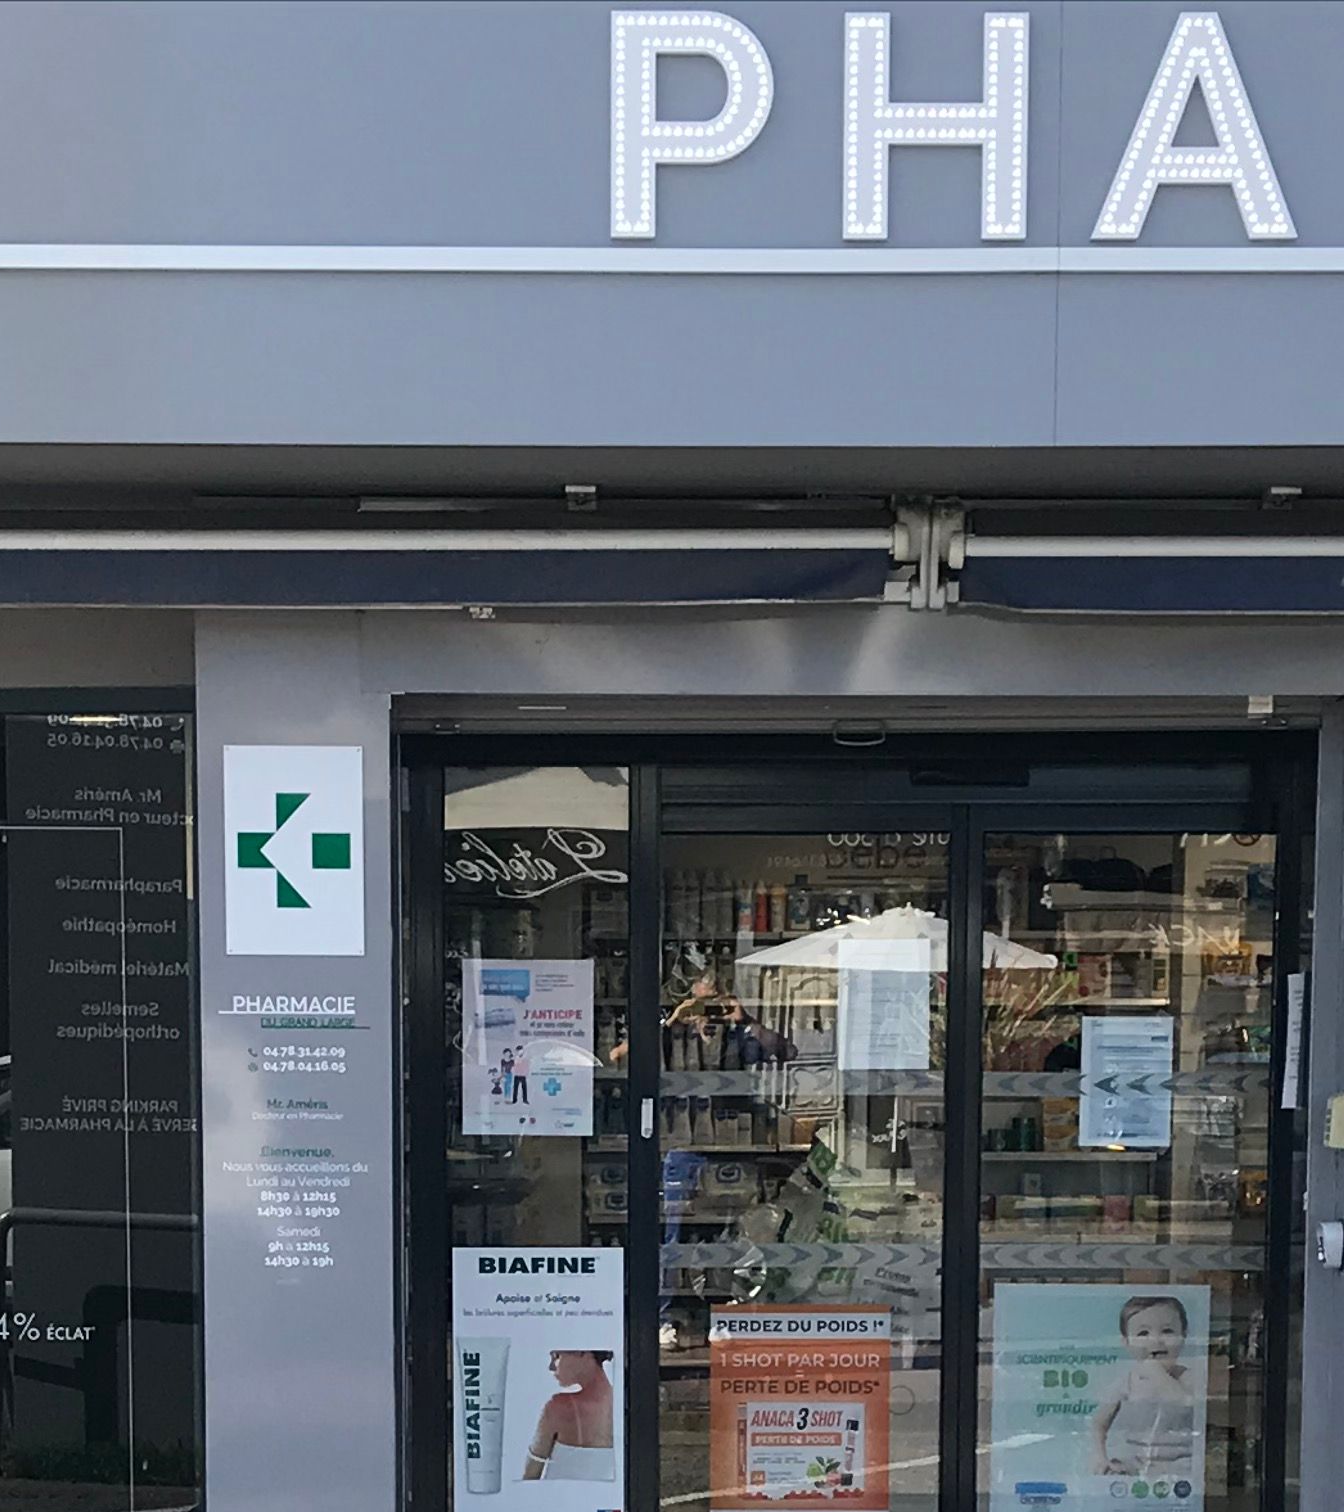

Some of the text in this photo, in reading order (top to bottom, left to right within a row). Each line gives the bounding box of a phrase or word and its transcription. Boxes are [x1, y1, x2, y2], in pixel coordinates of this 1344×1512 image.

[232, 995, 355, 1013] PHARMACIE
[523, 1009, 583, 1020] J'ANTICIPE
[262, 1046, 346, 1058] 04.78.31.42.09
[262, 1061, 346, 1074] 04.78.04.16.05
[352, 1161, 368, 1173] du
[297, 1176, 351, 1187] Vendredi
[261, 1191, 290, 1203] 8h30
[302, 1191, 336, 1203] 12h15
[257, 1206, 292, 1217] 14h30
[305, 1206, 340, 1217] 19h30
[277, 1226, 320, 1237] Samedi
[268, 1241, 283, 1253] 9h
[296, 1241, 330, 1253] 12h15
[265, 1256, 300, 1267] 14h30
[312, 1256, 334, 1267] 19h
[478, 1257, 596, 1274] BIAFINE
[495, 1293, 531, 1304] Apaise
[545, 1293, 581, 1305] Soigne
[716, 1319, 868, 1333] PERDEZ DU POIDS
[720, 1353, 880, 1367] 1 SHOT PAR JOUR
[721, 1380, 778, 1394] PERTE
[785, 1380, 810, 1394] DE
[463, 1352, 481, 1459] BIAFINE
[811, 1410, 843, 1427] SHOT
